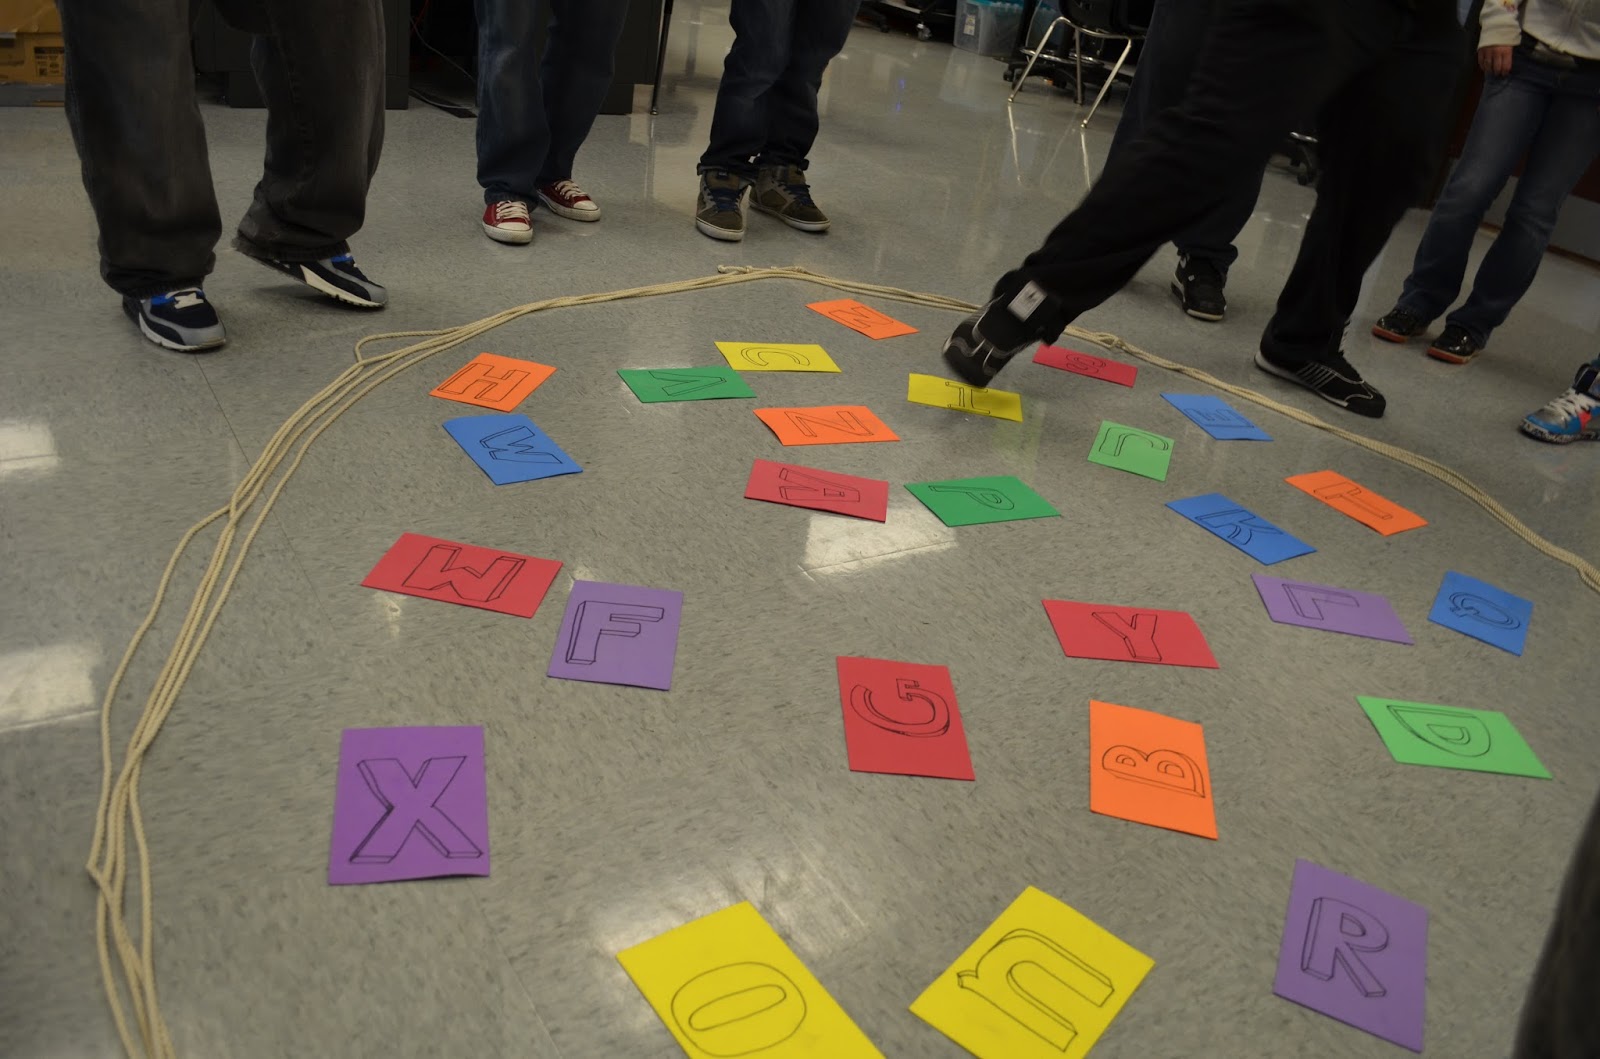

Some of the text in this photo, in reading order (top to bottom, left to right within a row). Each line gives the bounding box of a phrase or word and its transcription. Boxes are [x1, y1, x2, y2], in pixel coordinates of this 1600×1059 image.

[740, 347, 811, 367] C
[1065, 353, 1107, 374] S
[437, 362, 531, 402] H
[648, 370, 727, 397] V
[778, 467, 861, 503] A
[928, 485, 1015, 510] P
[1313, 480, 1394, 520] T
[1194, 508, 1284, 546] K
[1448, 590, 1522, 631] Q
[565, 600, 665, 665] F
[1090, 611, 1163, 662] Y
[849, 678, 951, 738] G
[1386, 704, 1492, 758] D
[1101, 744, 1206, 798] B
[349, 755, 484, 864] X
[1301, 896, 1390, 998] R
